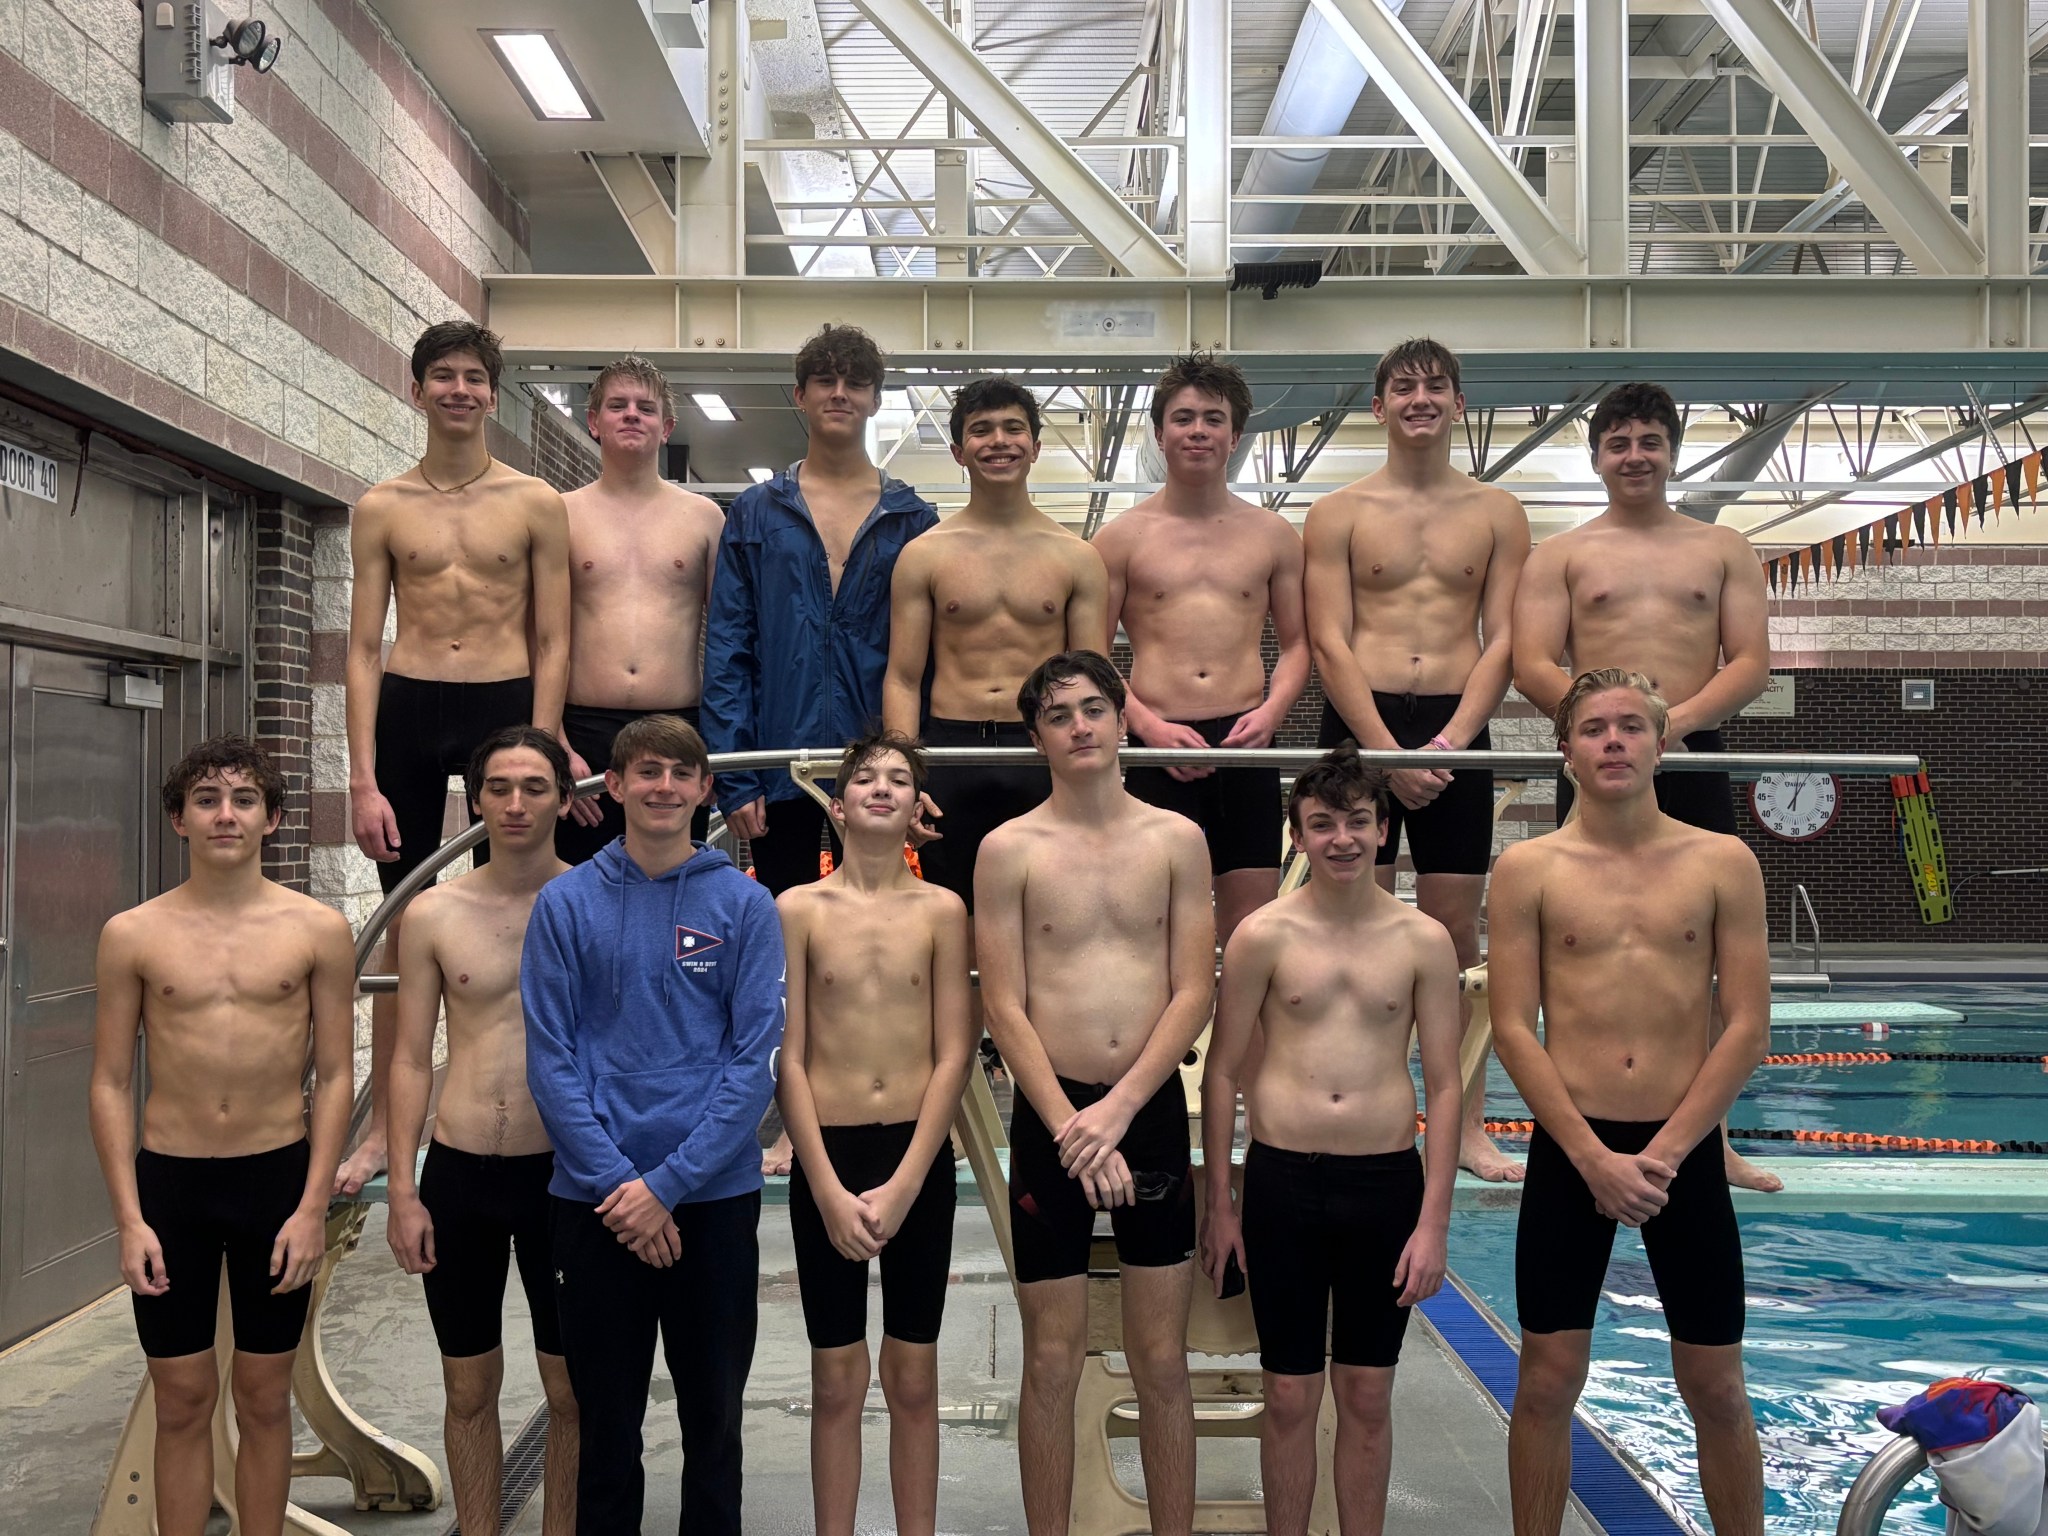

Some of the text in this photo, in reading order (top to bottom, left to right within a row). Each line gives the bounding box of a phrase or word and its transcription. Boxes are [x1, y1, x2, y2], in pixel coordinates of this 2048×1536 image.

[0, 444, 56, 498] DOOR 40
[1762, 776, 1771, 785] 50
[1821, 777, 1830, 785] 10
[1757, 793, 1766, 801] 45
[1825, 794, 1834, 802] 15
[1761, 810, 1770, 818] 40
[1820, 811, 1829, 819] 20
[1773, 822, 1783, 831] 35
[1807, 823, 1817, 831] 25
[1790, 827, 1800, 836] 30
